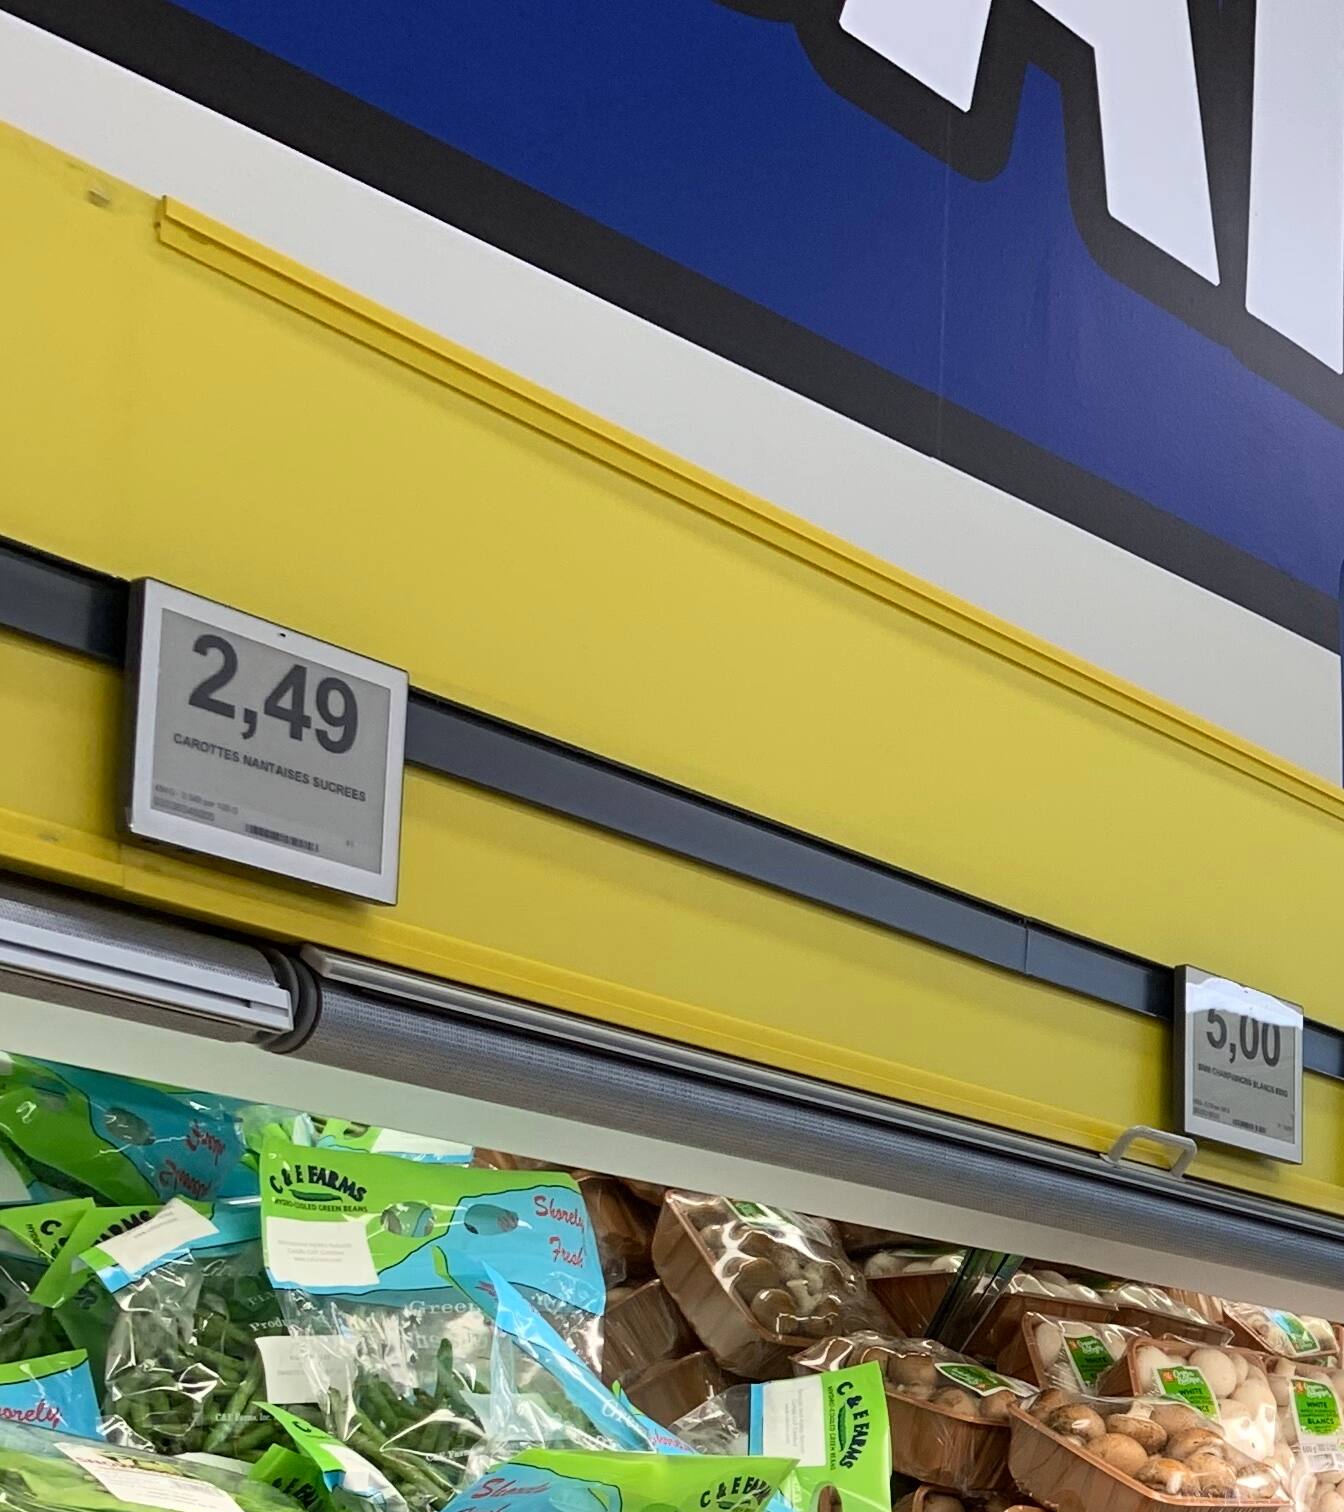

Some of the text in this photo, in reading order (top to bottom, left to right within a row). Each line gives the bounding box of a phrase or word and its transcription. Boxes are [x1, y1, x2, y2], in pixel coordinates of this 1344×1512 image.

[188, 634, 359, 754] 2,49
[173, 733, 366, 802] CAROTTES NANTAISES SUCREES
[1206, 1009, 1280, 1067] 5,00
[269, 1164, 368, 1202] C & E FARMS
[317, 1202, 341, 1212] GREEN
[343, 1204, 368, 1213] BEANS
[836, 1381, 854, 1397] C
[0, 1398, 60, 1428] orely
[853, 1409, 869, 1421] E
[839, 1422, 870, 1469] FARMS
[700, 1490, 711, 1508] C
[731, 1476, 742, 1494] E
